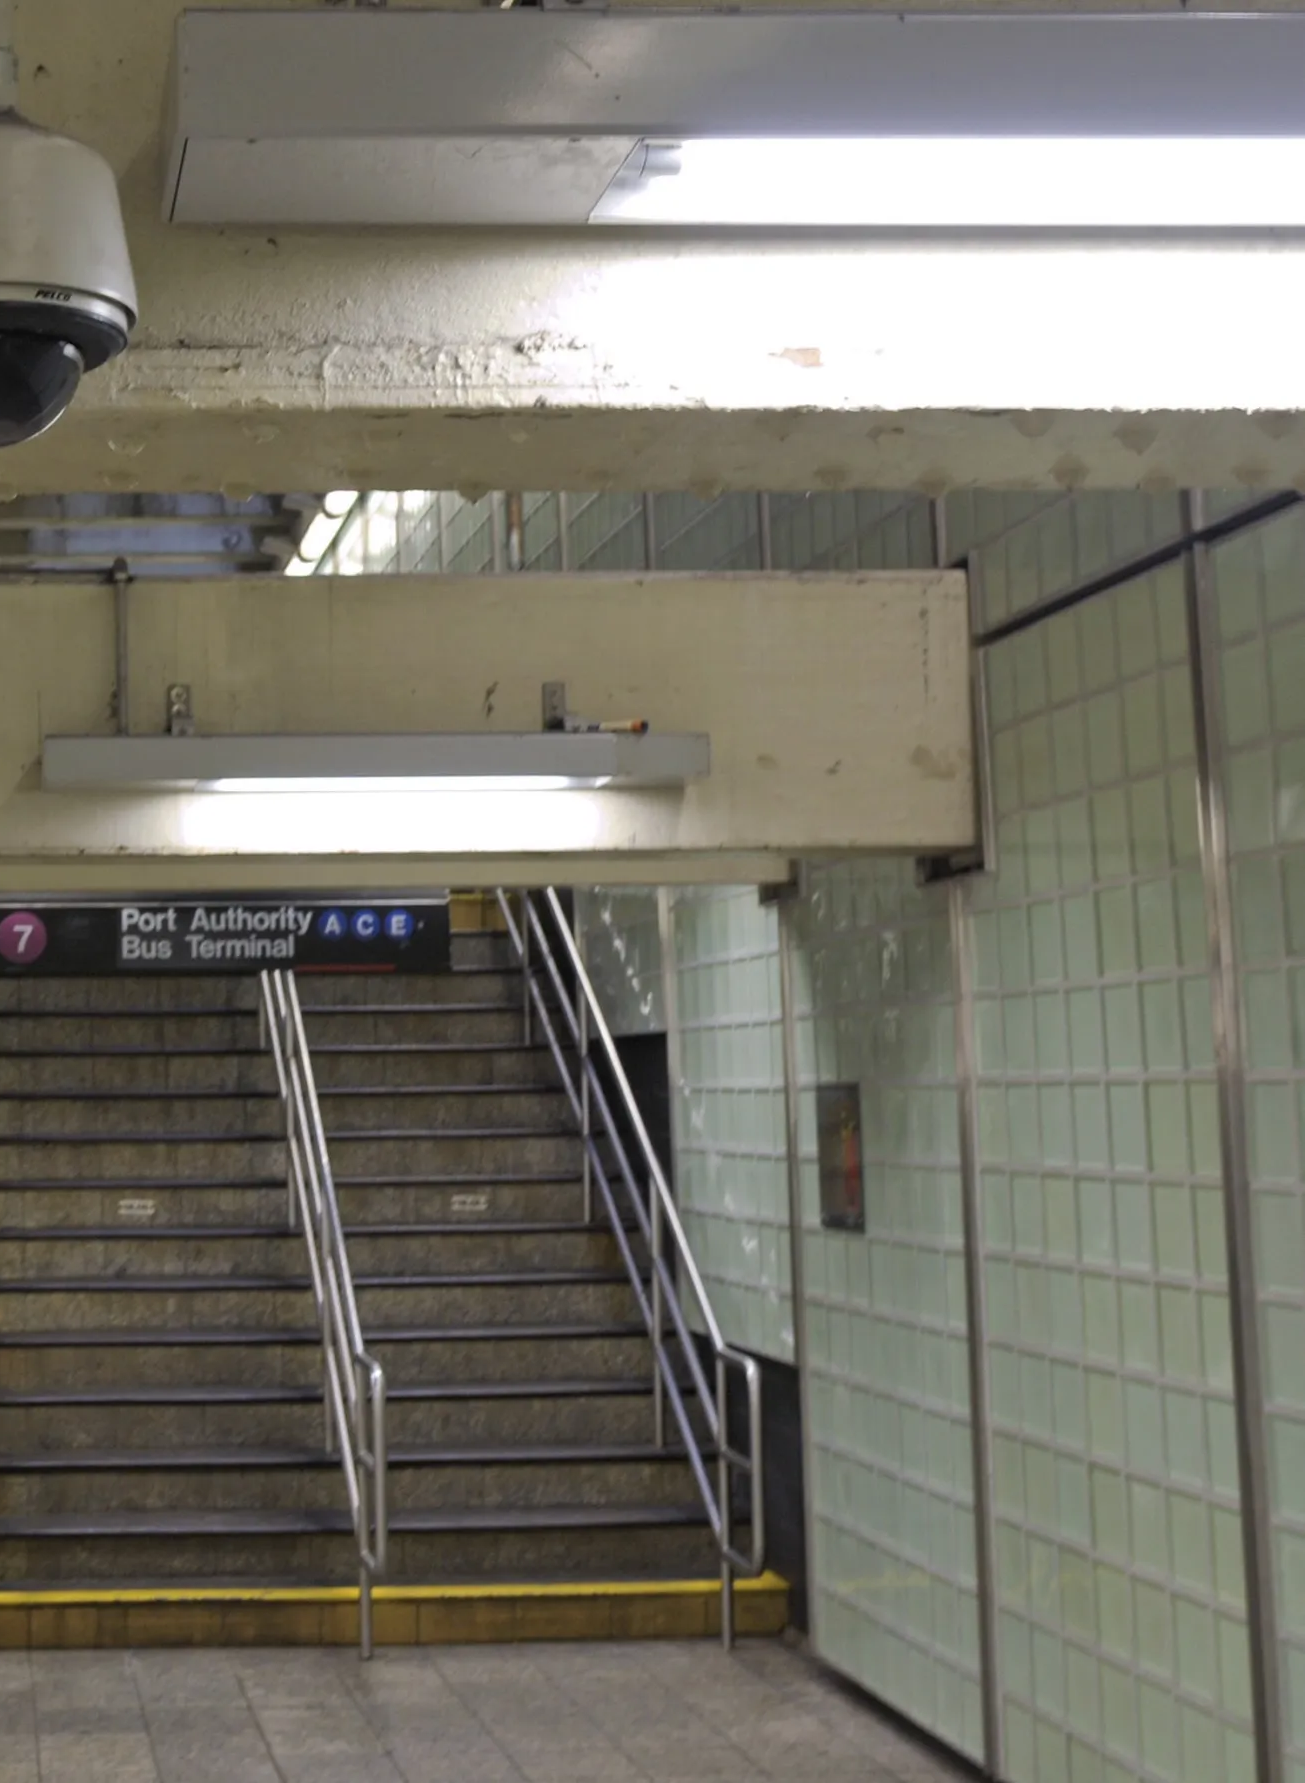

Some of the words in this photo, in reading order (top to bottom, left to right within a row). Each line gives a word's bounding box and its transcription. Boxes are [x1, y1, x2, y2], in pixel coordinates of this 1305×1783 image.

[35, 289, 72, 301] PELCO
[121, 907, 177, 932] Port
[190, 907, 313, 935] Authority
[324, 914, 341, 935] A
[356, 914, 374, 936] C
[391, 914, 407, 936] E
[13, 924, 33, 954] 7
[121, 934, 172, 959] Bus
[184, 933, 295, 959] Terminal
